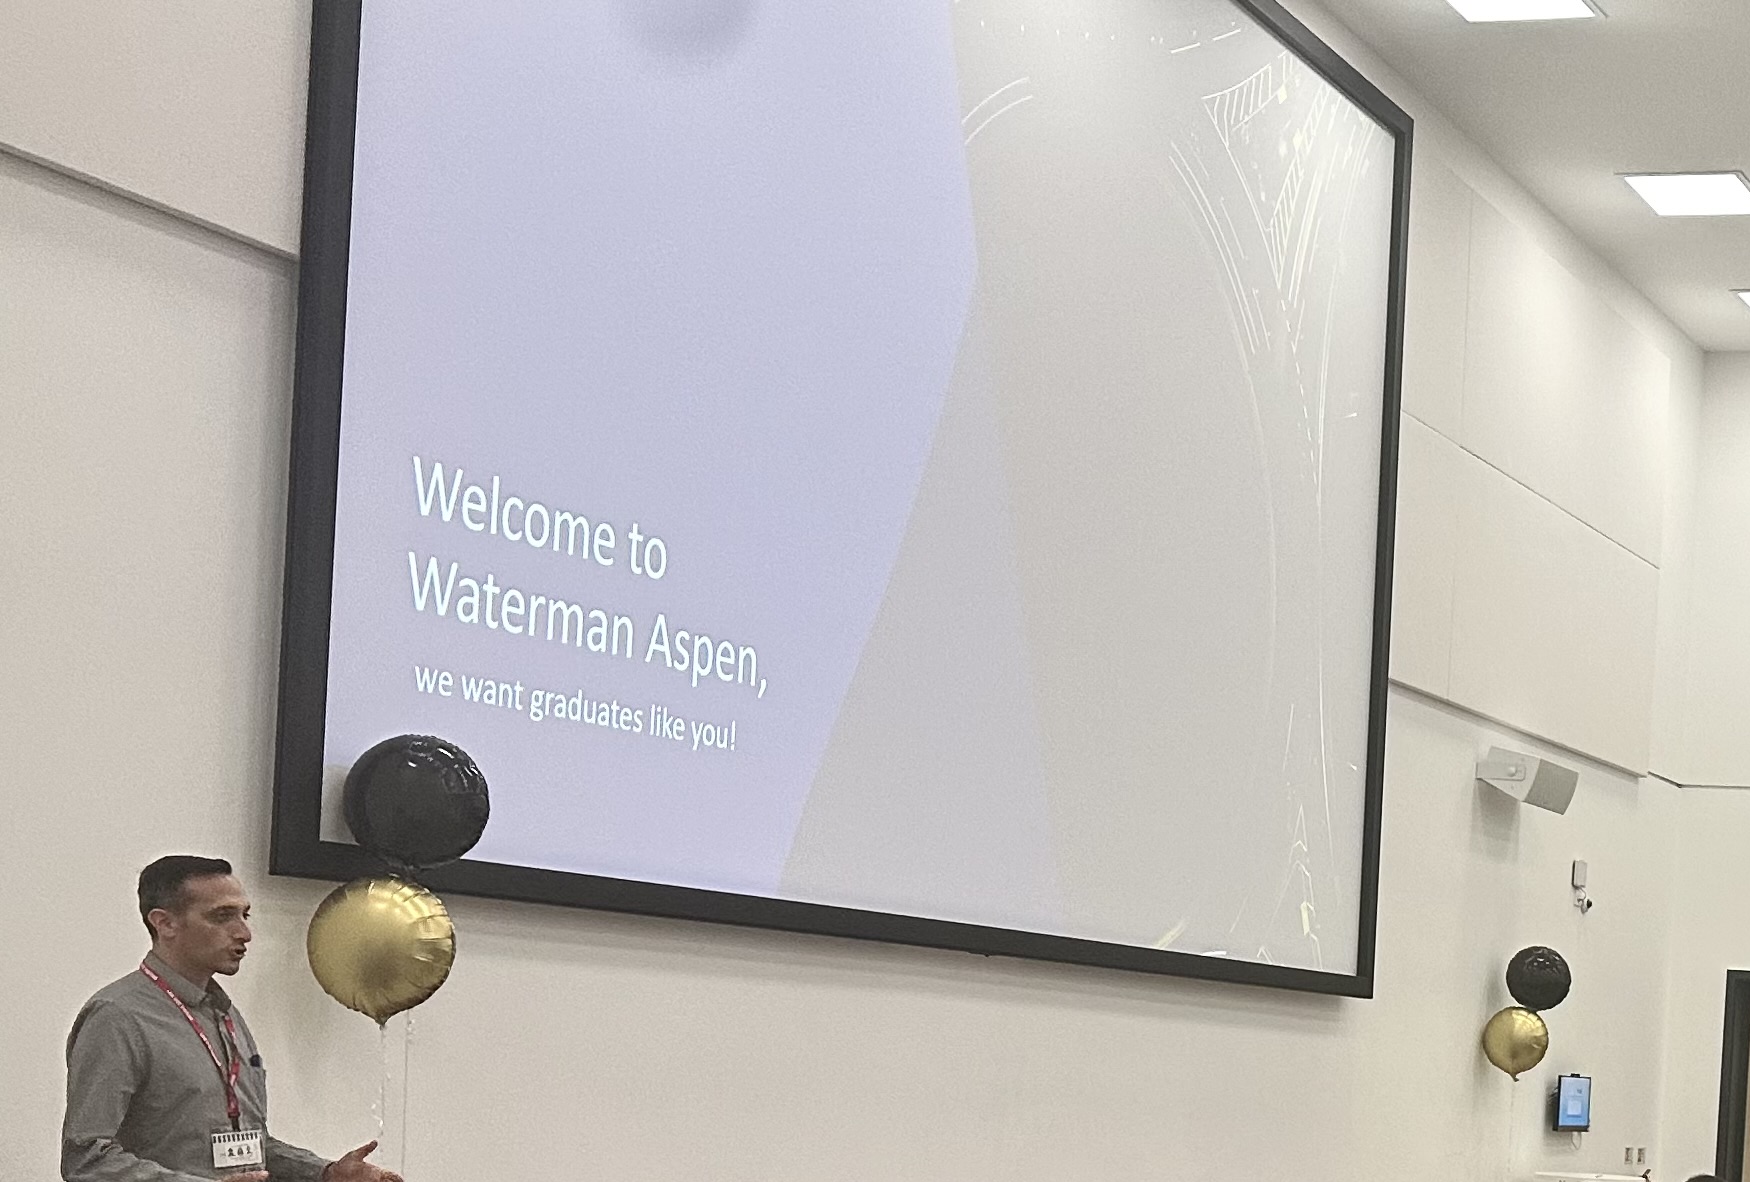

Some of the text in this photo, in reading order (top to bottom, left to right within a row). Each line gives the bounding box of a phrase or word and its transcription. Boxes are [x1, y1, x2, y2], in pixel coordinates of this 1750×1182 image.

[412, 455, 668, 580] Welcome to
[407, 551, 768, 699] Waterman Aspen,
[414, 665, 737, 751] we want graduates like you!
